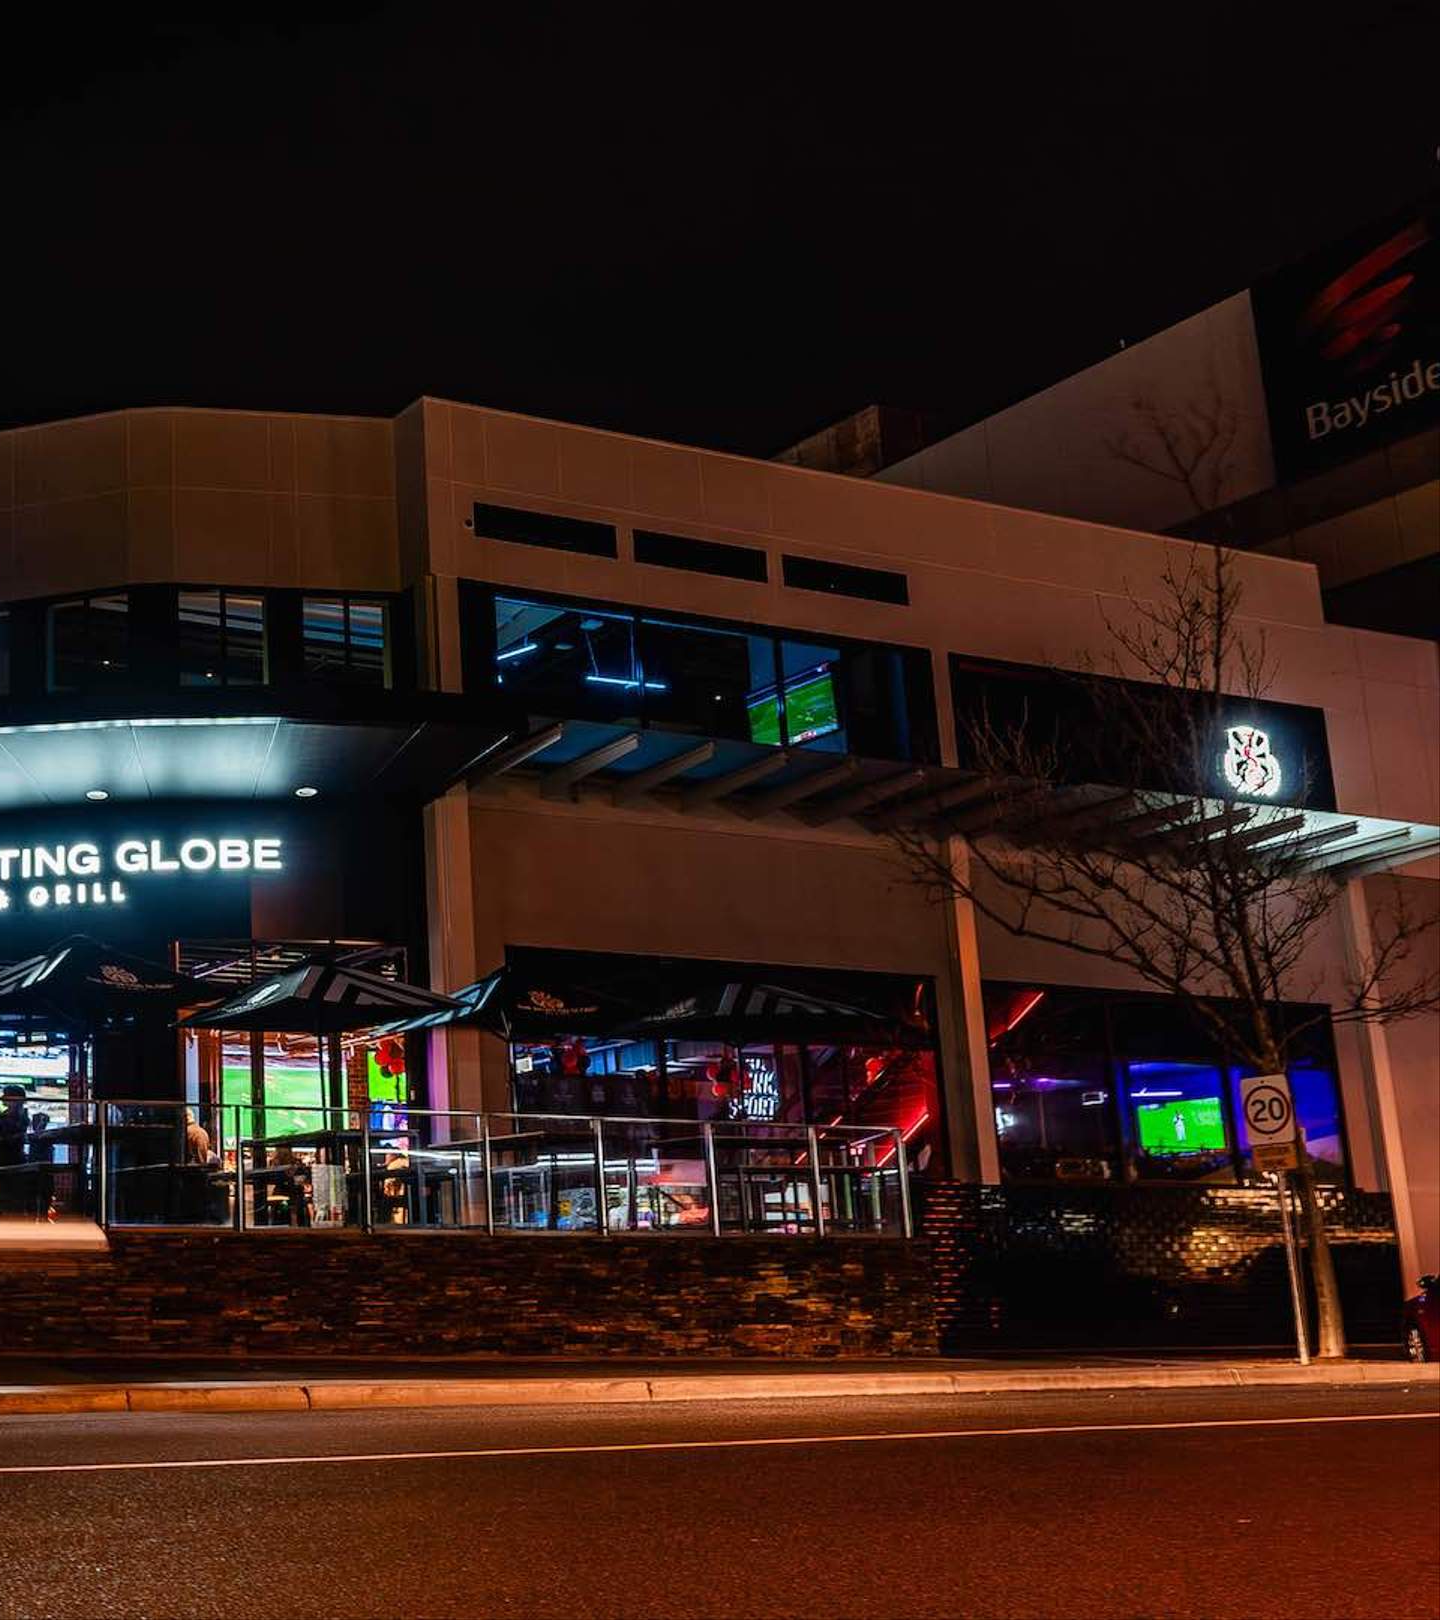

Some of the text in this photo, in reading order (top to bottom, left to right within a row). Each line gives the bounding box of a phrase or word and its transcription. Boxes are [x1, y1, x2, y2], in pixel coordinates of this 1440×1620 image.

[1305, 358, 1440, 441] Bayside
[115, 838, 283, 873] GLOBE
[28, 881, 127, 908] GRILL
[1251, 1097, 1285, 1123] 20
